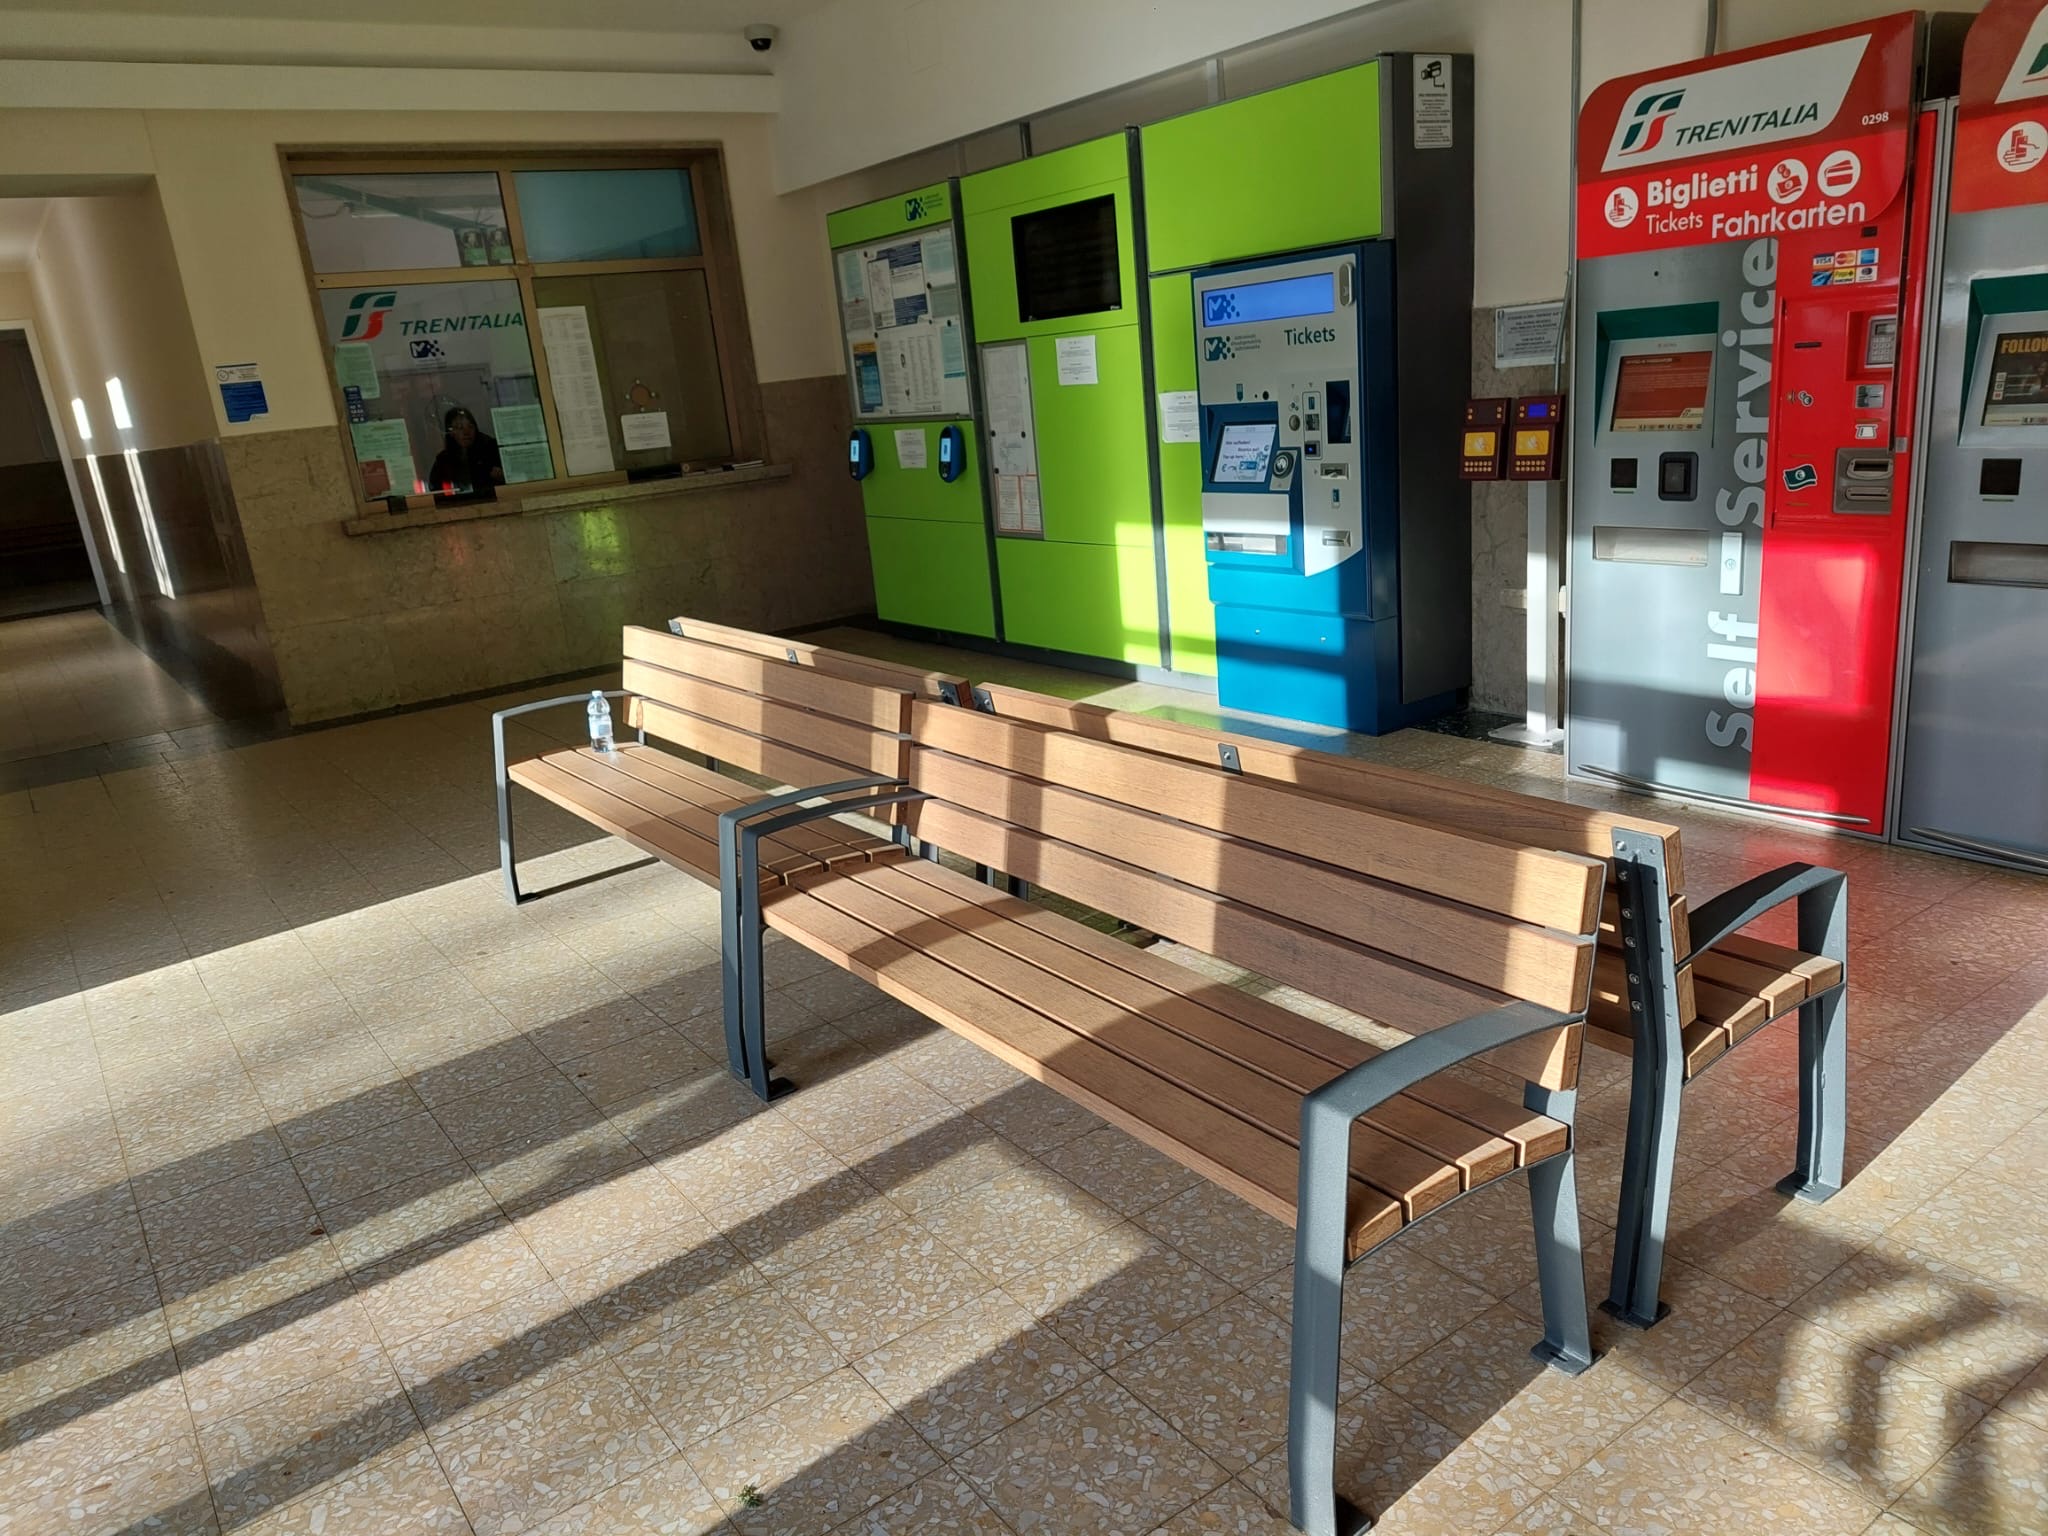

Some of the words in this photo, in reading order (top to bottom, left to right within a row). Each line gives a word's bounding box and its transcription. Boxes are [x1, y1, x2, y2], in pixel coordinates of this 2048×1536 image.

[1675, 101, 1819, 146] TRENITALIA
[1861, 111, 1889, 126] 0298
[1647, 163, 1759, 209] Biglietti
[1645, 211, 1704, 235] Tickets
[1710, 200, 1866, 239] Fahrkarten
[400, 312, 523, 336] TRENITALIA
[1284, 326, 1336, 346] Tickets
